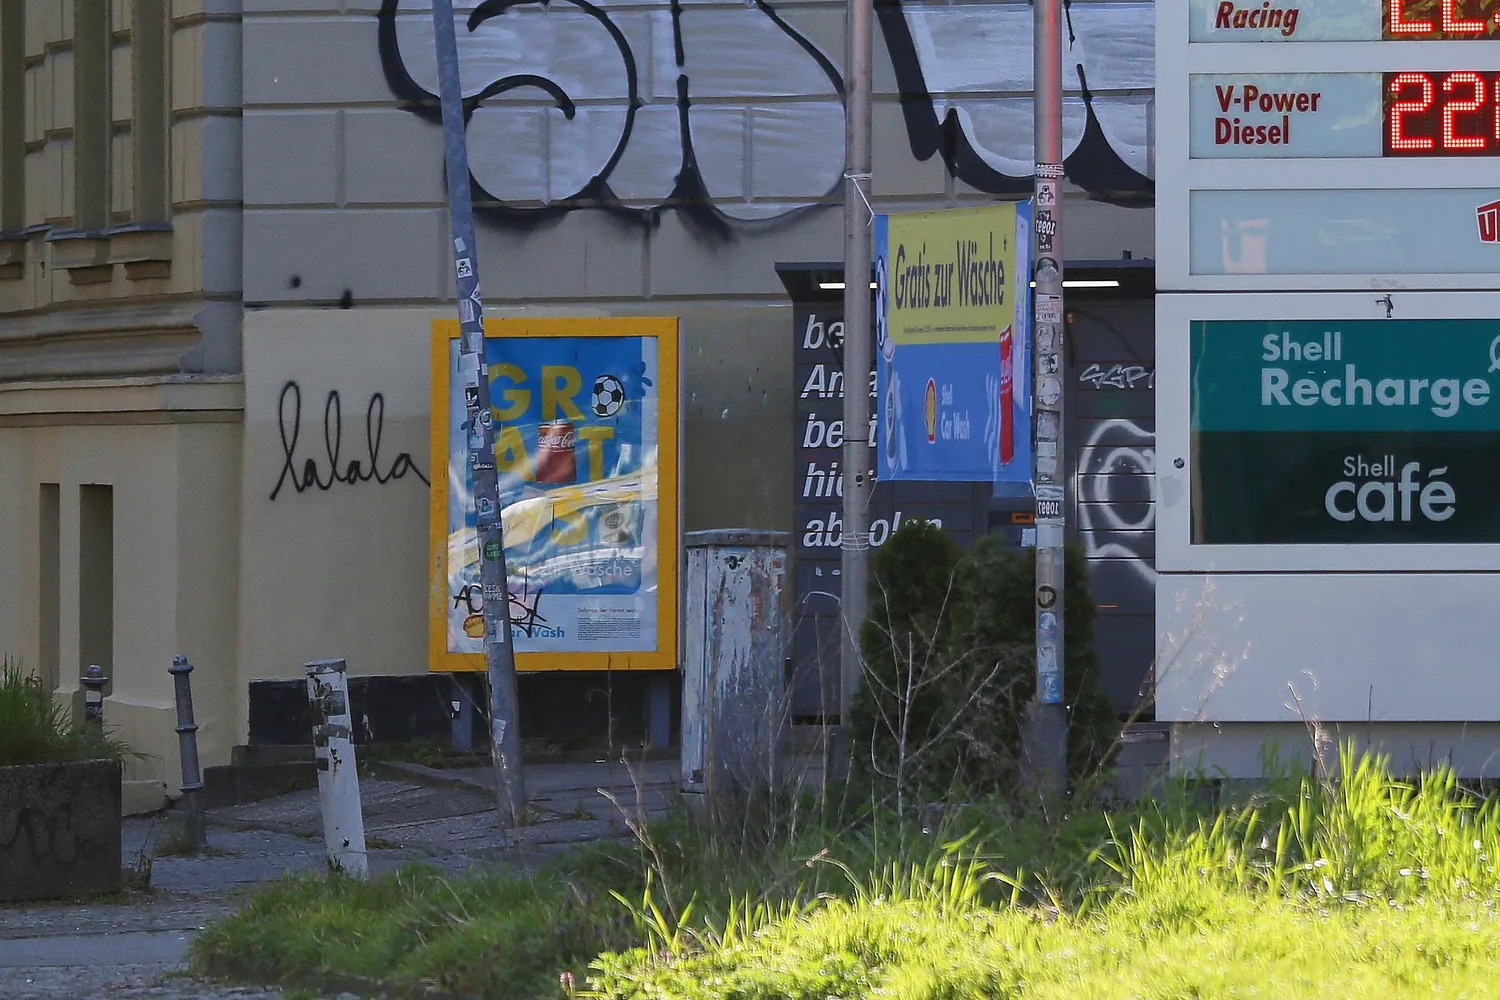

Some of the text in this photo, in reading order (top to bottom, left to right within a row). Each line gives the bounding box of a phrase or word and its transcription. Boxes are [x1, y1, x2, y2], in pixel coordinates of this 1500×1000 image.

[1215, 1, 1300, 37] Racing
[1215, 85, 1321, 113] V-Power
[1215, 117, 1290, 146] Diesel
[895, 241, 931, 310] Gratis
[933, 262, 954, 307] zur
[1262, 332, 1341, 362] Shell
[1261, 364, 1490, 417] Recharge
[1343, 455, 1395, 477] Shell
[1325, 462, 1456, 522] café
[803, 512, 942, 547] abol
